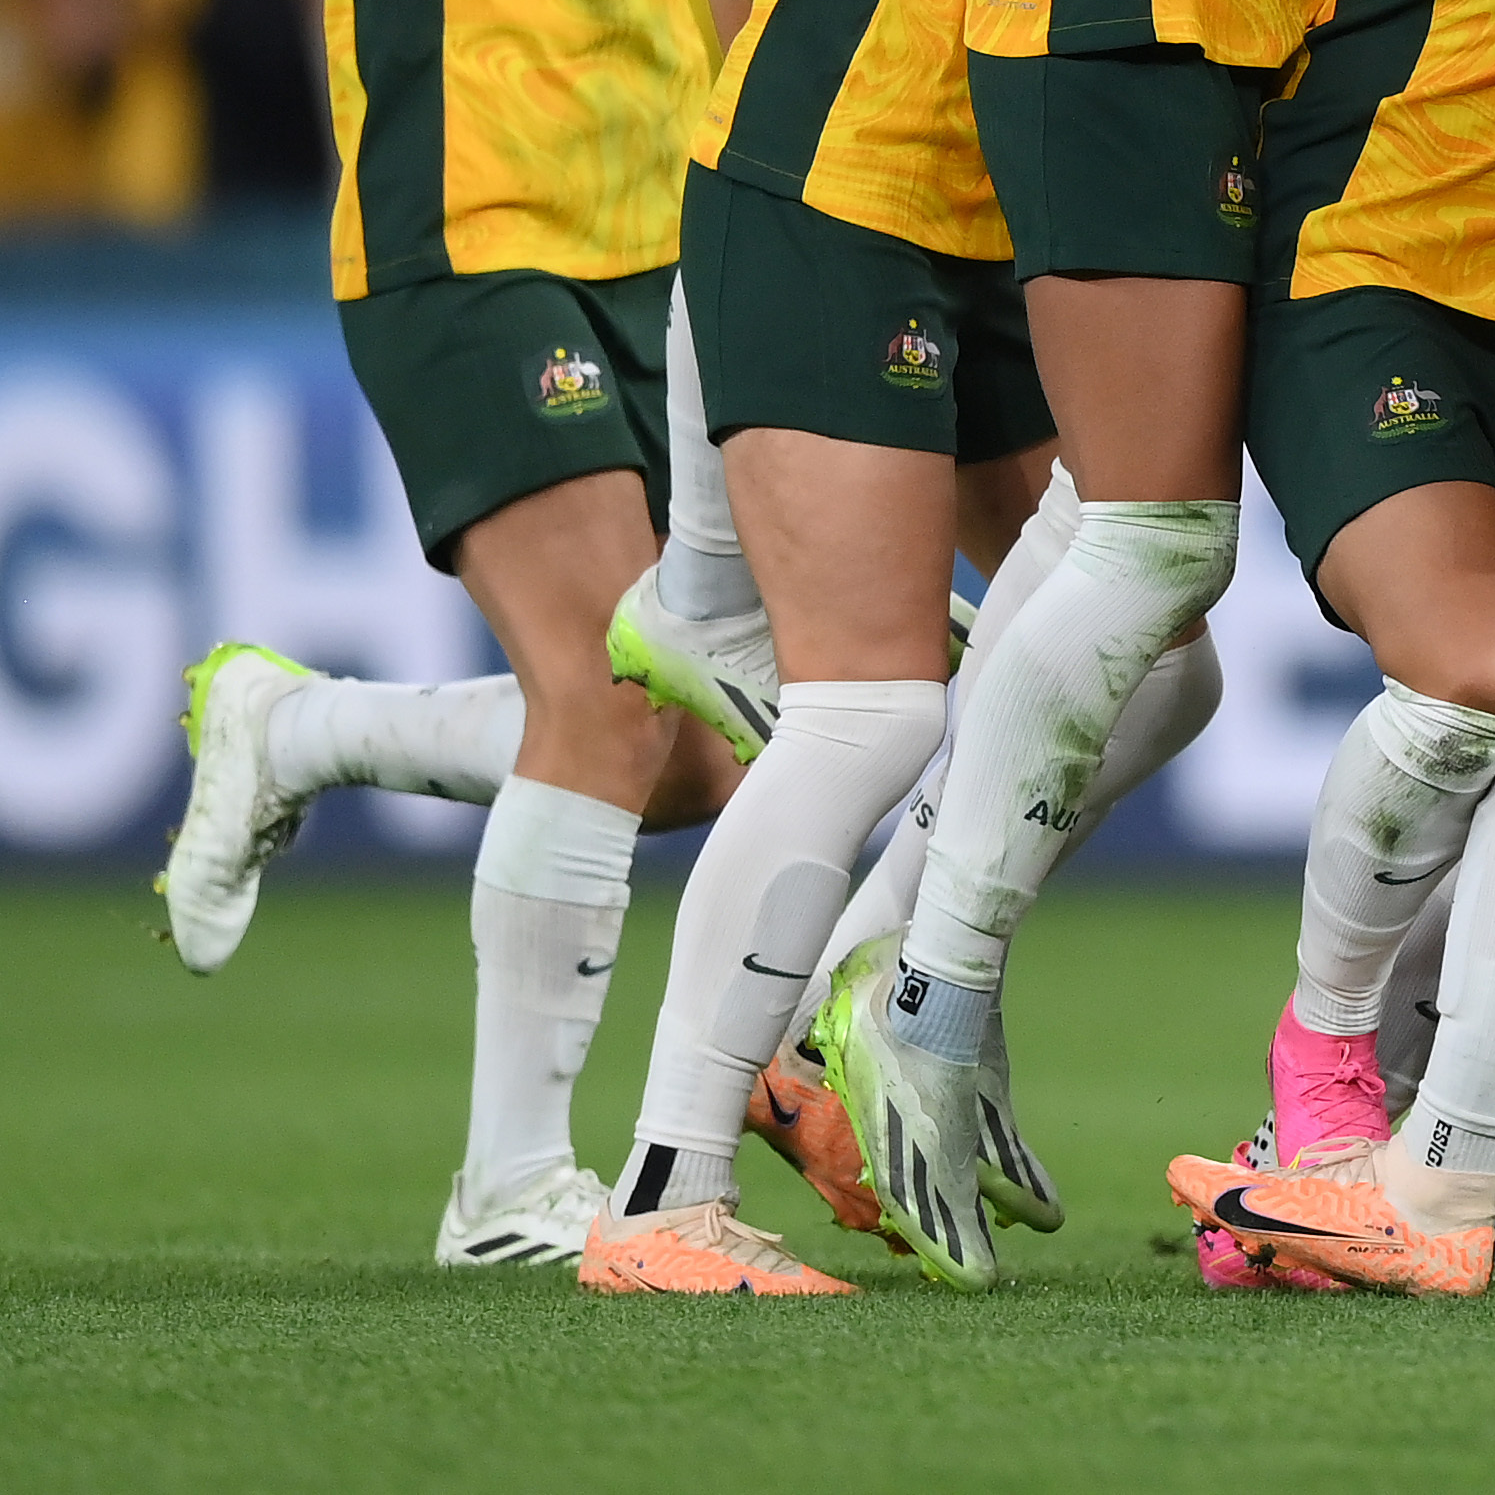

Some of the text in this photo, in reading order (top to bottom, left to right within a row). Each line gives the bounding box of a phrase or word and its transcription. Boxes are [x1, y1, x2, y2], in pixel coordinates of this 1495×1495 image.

[888, 364, 938, 378] AUSTRALIA
[1378, 412, 1440, 430] AUSTRALIA
[1425, 1119, 1452, 1167] ESIG
